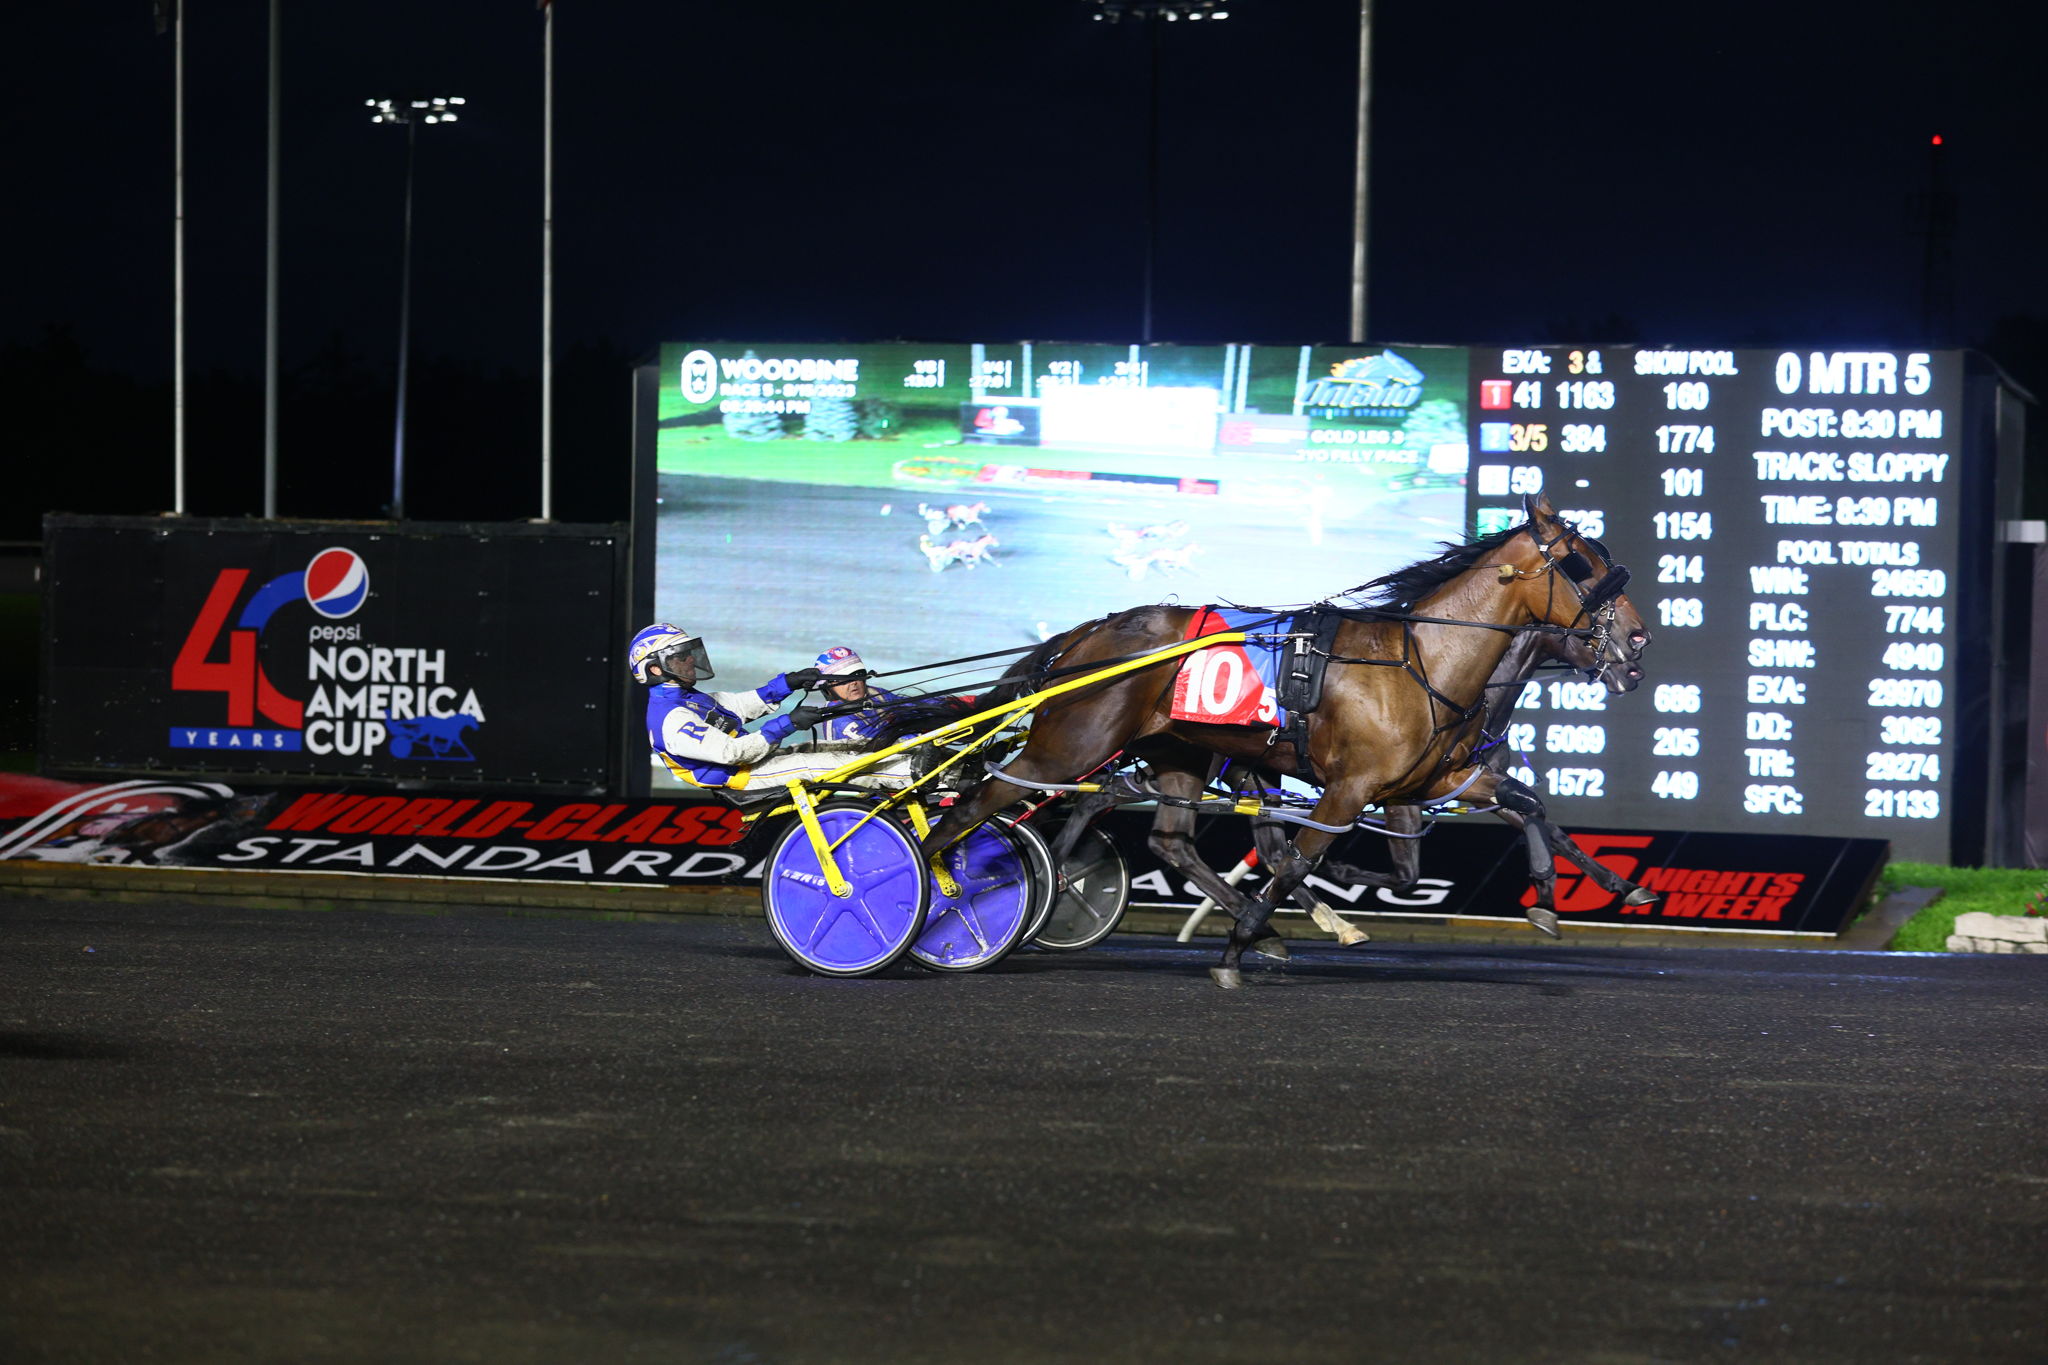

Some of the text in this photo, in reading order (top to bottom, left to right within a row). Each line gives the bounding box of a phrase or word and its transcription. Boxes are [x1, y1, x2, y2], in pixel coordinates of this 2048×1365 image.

[720, 358, 859, 382] WOODBINE
[1503, 350, 1602, 374] EXA: 3 &
[1635, 350, 1738, 376] SHOW POOL
[1775, 352, 1931, 395] 0 MTR 5
[719, 383, 761, 397] RACE
[1513, 381, 1615, 410] 41 1163
[1664, 382, 1709, 410] 160
[786, 400, 811, 414] PM
[1311, 429, 1357, 444] GOLD
[1761, 408, 1942, 438] POST: 8:30 PM
[1509, 424, 1606, 452] 3/5 384
[1656, 425, 1714, 454] 1774
[1375, 450, 1419, 464] PACE
[1753, 452, 1949, 482] TRACK: SLOPPY
[1511, 466, 1543, 495] 59
[1661, 468, 1703, 497] 101
[1760, 495, 1937, 526] TIME: 8:39 PM
[1653, 511, 1712, 540] 1154
[1777, 540, 1919, 566] POOL TOTALS
[1658, 554, 1704, 583] 214
[1750, 566, 1808, 594] WIN:
[1658, 598, 1703, 627] 193
[1749, 602, 1808, 631] PLC:
[1884, 605, 1944, 633] 7744
[309, 623, 362, 643] pepsi
[308, 646, 445, 684] NORTH
[1748, 639, 1815, 668] SHW:
[1882, 642, 1944, 671] 4940
[1182, 649, 1244, 716] 10
[1548, 681, 1607, 711] 1032
[1747, 675, 1806, 704] EXA:
[304, 686, 486, 723] AMERICA
[1257, 686, 1277, 723] 5
[186, 731, 285, 748] YEARS
[304, 720, 387, 757] CUP
[677, 720, 710, 744] R
[1747, 711, 1793, 741] DD:
[1880, 715, 1941, 745] 3062
[1653, 727, 1700, 757] 205
[1545, 767, 1604, 797] 1572
[1651, 770, 1699, 800] 449
[1744, 784, 1803, 814] SFC:
[1864, 788, 1939, 819] 21133
[264, 793, 751, 846] WORLD-CLASS
[217, 836, 767, 879] STANDARD
[1520, 833, 1805, 912] 5 NIGHTS
[1661, 892, 1793, 922] WEEK
